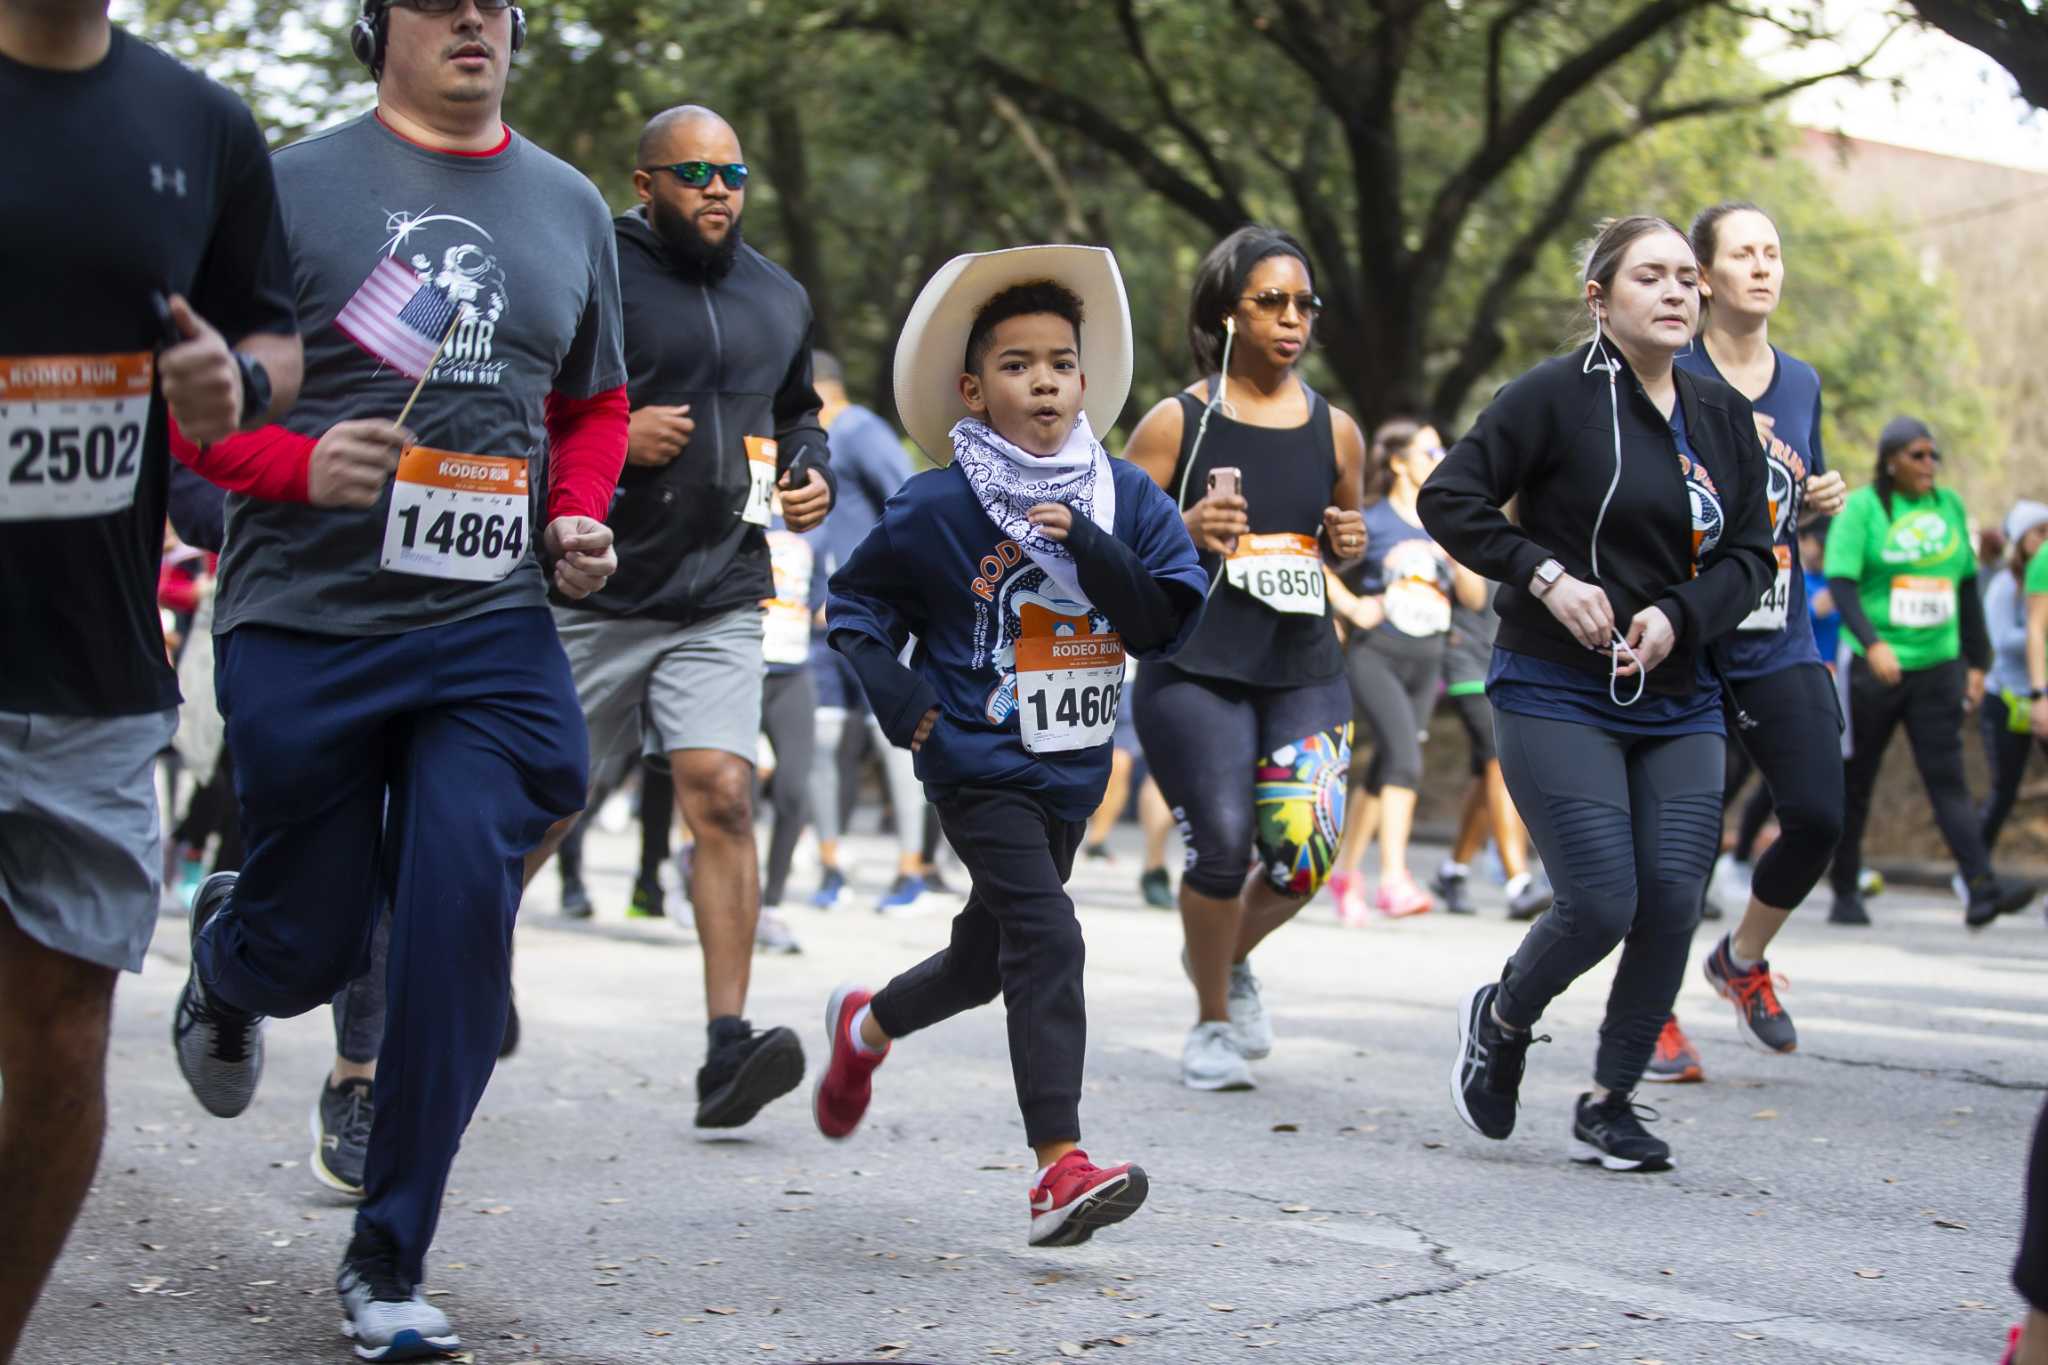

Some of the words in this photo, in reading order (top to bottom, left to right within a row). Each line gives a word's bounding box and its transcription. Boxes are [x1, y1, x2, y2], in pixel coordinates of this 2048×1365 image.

[10, 366, 77, 387] RODEO
[81, 363, 117, 385] RUN
[8, 420, 141, 487] 2502
[438, 461, 488, 480] RODEO
[398, 504, 523, 559] 14864
[971, 539, 1022, 602] ROD
[1236, 568, 1321, 598] 16850
[1052, 643, 1097, 657] RODEO
[1100, 641, 1120, 655] RUN
